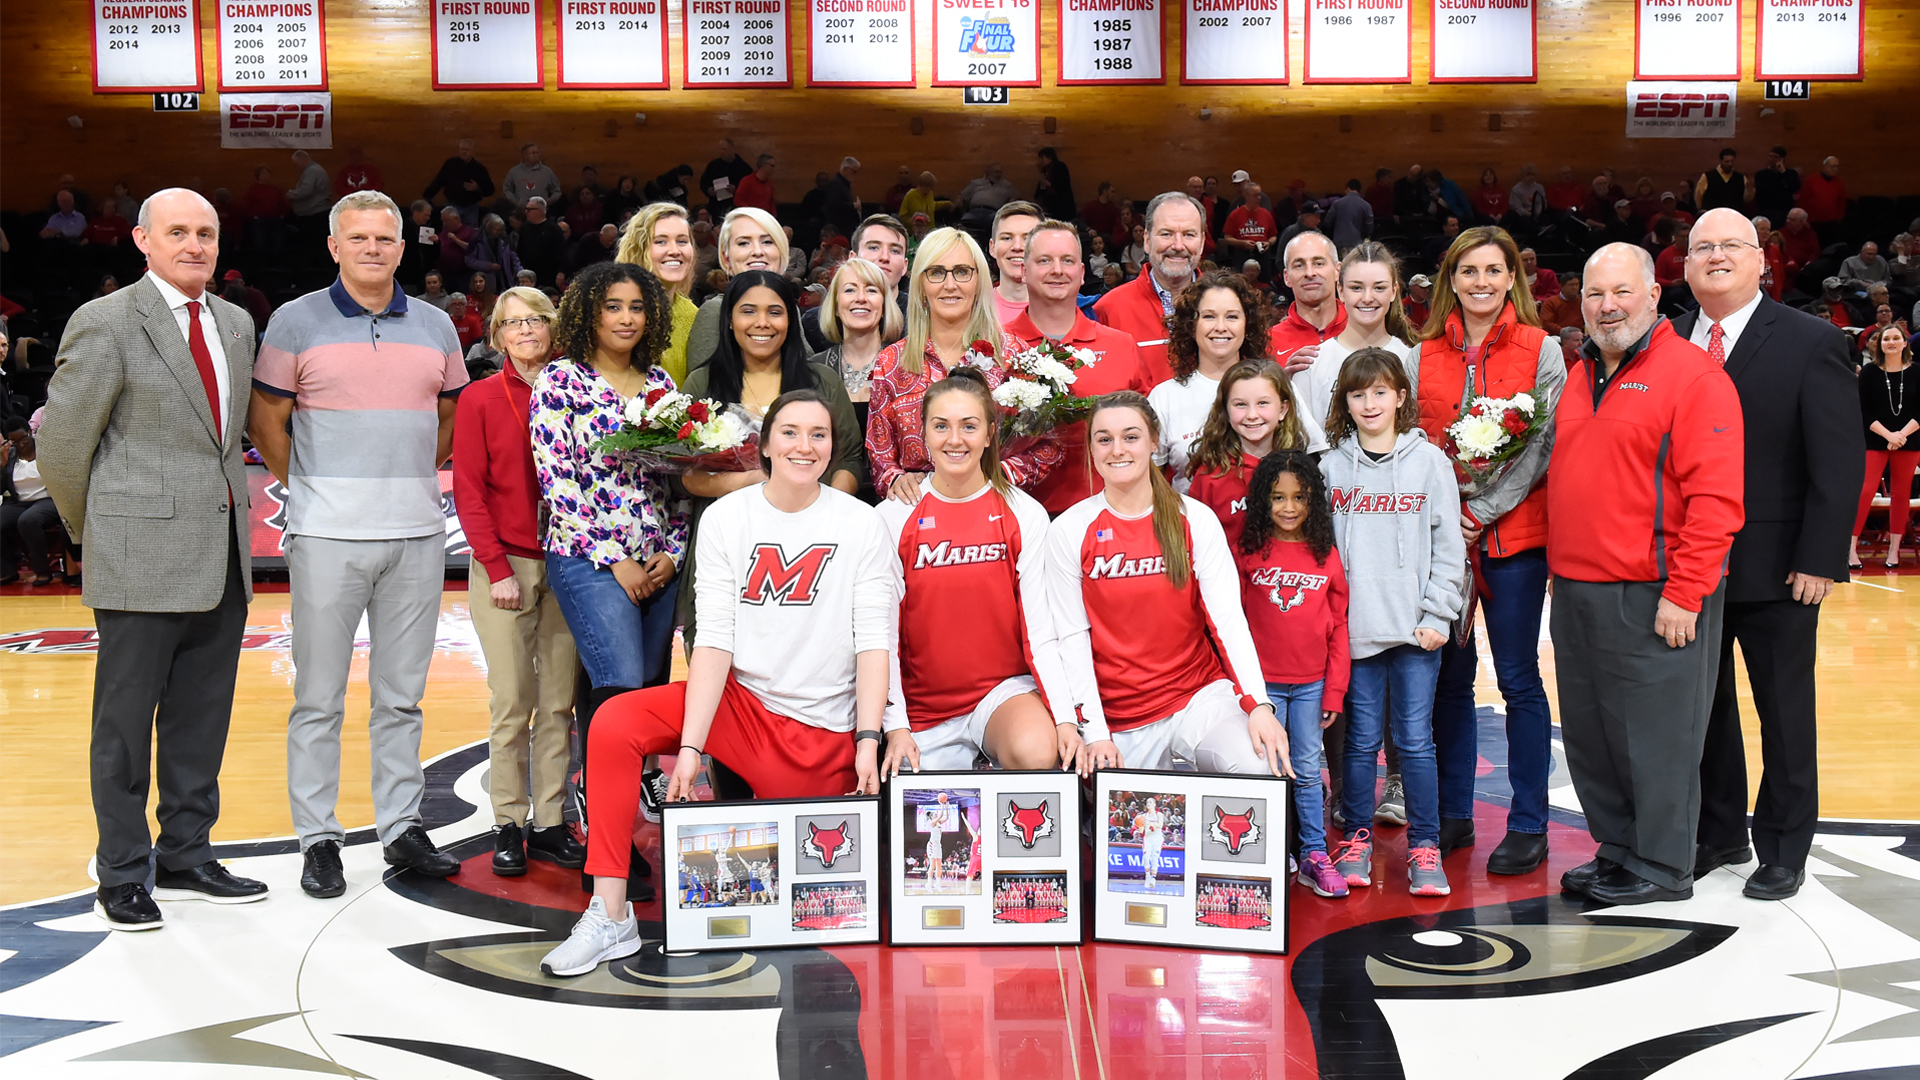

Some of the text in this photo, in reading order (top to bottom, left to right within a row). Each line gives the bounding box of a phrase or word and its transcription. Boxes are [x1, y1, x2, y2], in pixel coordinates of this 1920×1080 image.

[442, 2, 530, 15] FIRST ROUND
[568, 1, 655, 14] FIRST ROUND
[693, 0, 781, 14] FIRST ROUND
[816, 0, 906, 13] SECOND ROUND
[1069, 0, 1154, 11] CHAMPIONS
[1193, 0, 1278, 11] CHAMPIONS
[1316, 0, 1403, 9] FIRST ROUND
[102, 5, 187, 19] CHAMPIONS
[226, 3, 312, 18] CHAMPIONS
[1199, 17, 1271, 27] 2002 2007
[1324, 16, 1395, 25] 1986 1987
[1448, 15, 1476, 24] 2007
[1654, 13, 1724, 22] 1996 2007
[1776, 12, 1847, 22] 2013 2014
[233, 23, 306, 33] 2004 2005
[450, 22, 480, 31] 2015
[576, 20, 648, 30] 2013 2014
[700, 20, 773, 29] 2004 2006
[825, 18, 899, 28] 2007 2008
[1093, 20, 1132, 32] 1985
[109, 24, 181, 34] 2012 2013
[450, 33, 480, 42] 2018
[701, 35, 774, 45] 2007 2008
[825, 34, 898, 44] 2011 2012
[109, 40, 139, 49] 2014
[234, 38, 307, 49] 2006 2007
[1093, 39, 1132, 51] 1987
[234, 54, 308, 64] 2008 2009
[701, 51, 774, 60] 2009 2010
[968, 63, 1006, 75] 2007
[1094, 58, 1133, 70] 1988
[235, 69, 308, 80] 2010 2011
[701, 66, 774, 76] 2011 2012
[971, 87, 1002, 102] 103
[1771, 81, 1804, 97] 104
[160, 93, 193, 108] 102
[1634, 93, 1730, 118] ESPN
[229, 104, 326, 129] ESPN
[1330, 485, 1428, 515] MARIST
[1088, 552, 1167, 580] MARI
[740, 543, 838, 606] M
[1251, 567, 1328, 591] MARIST
